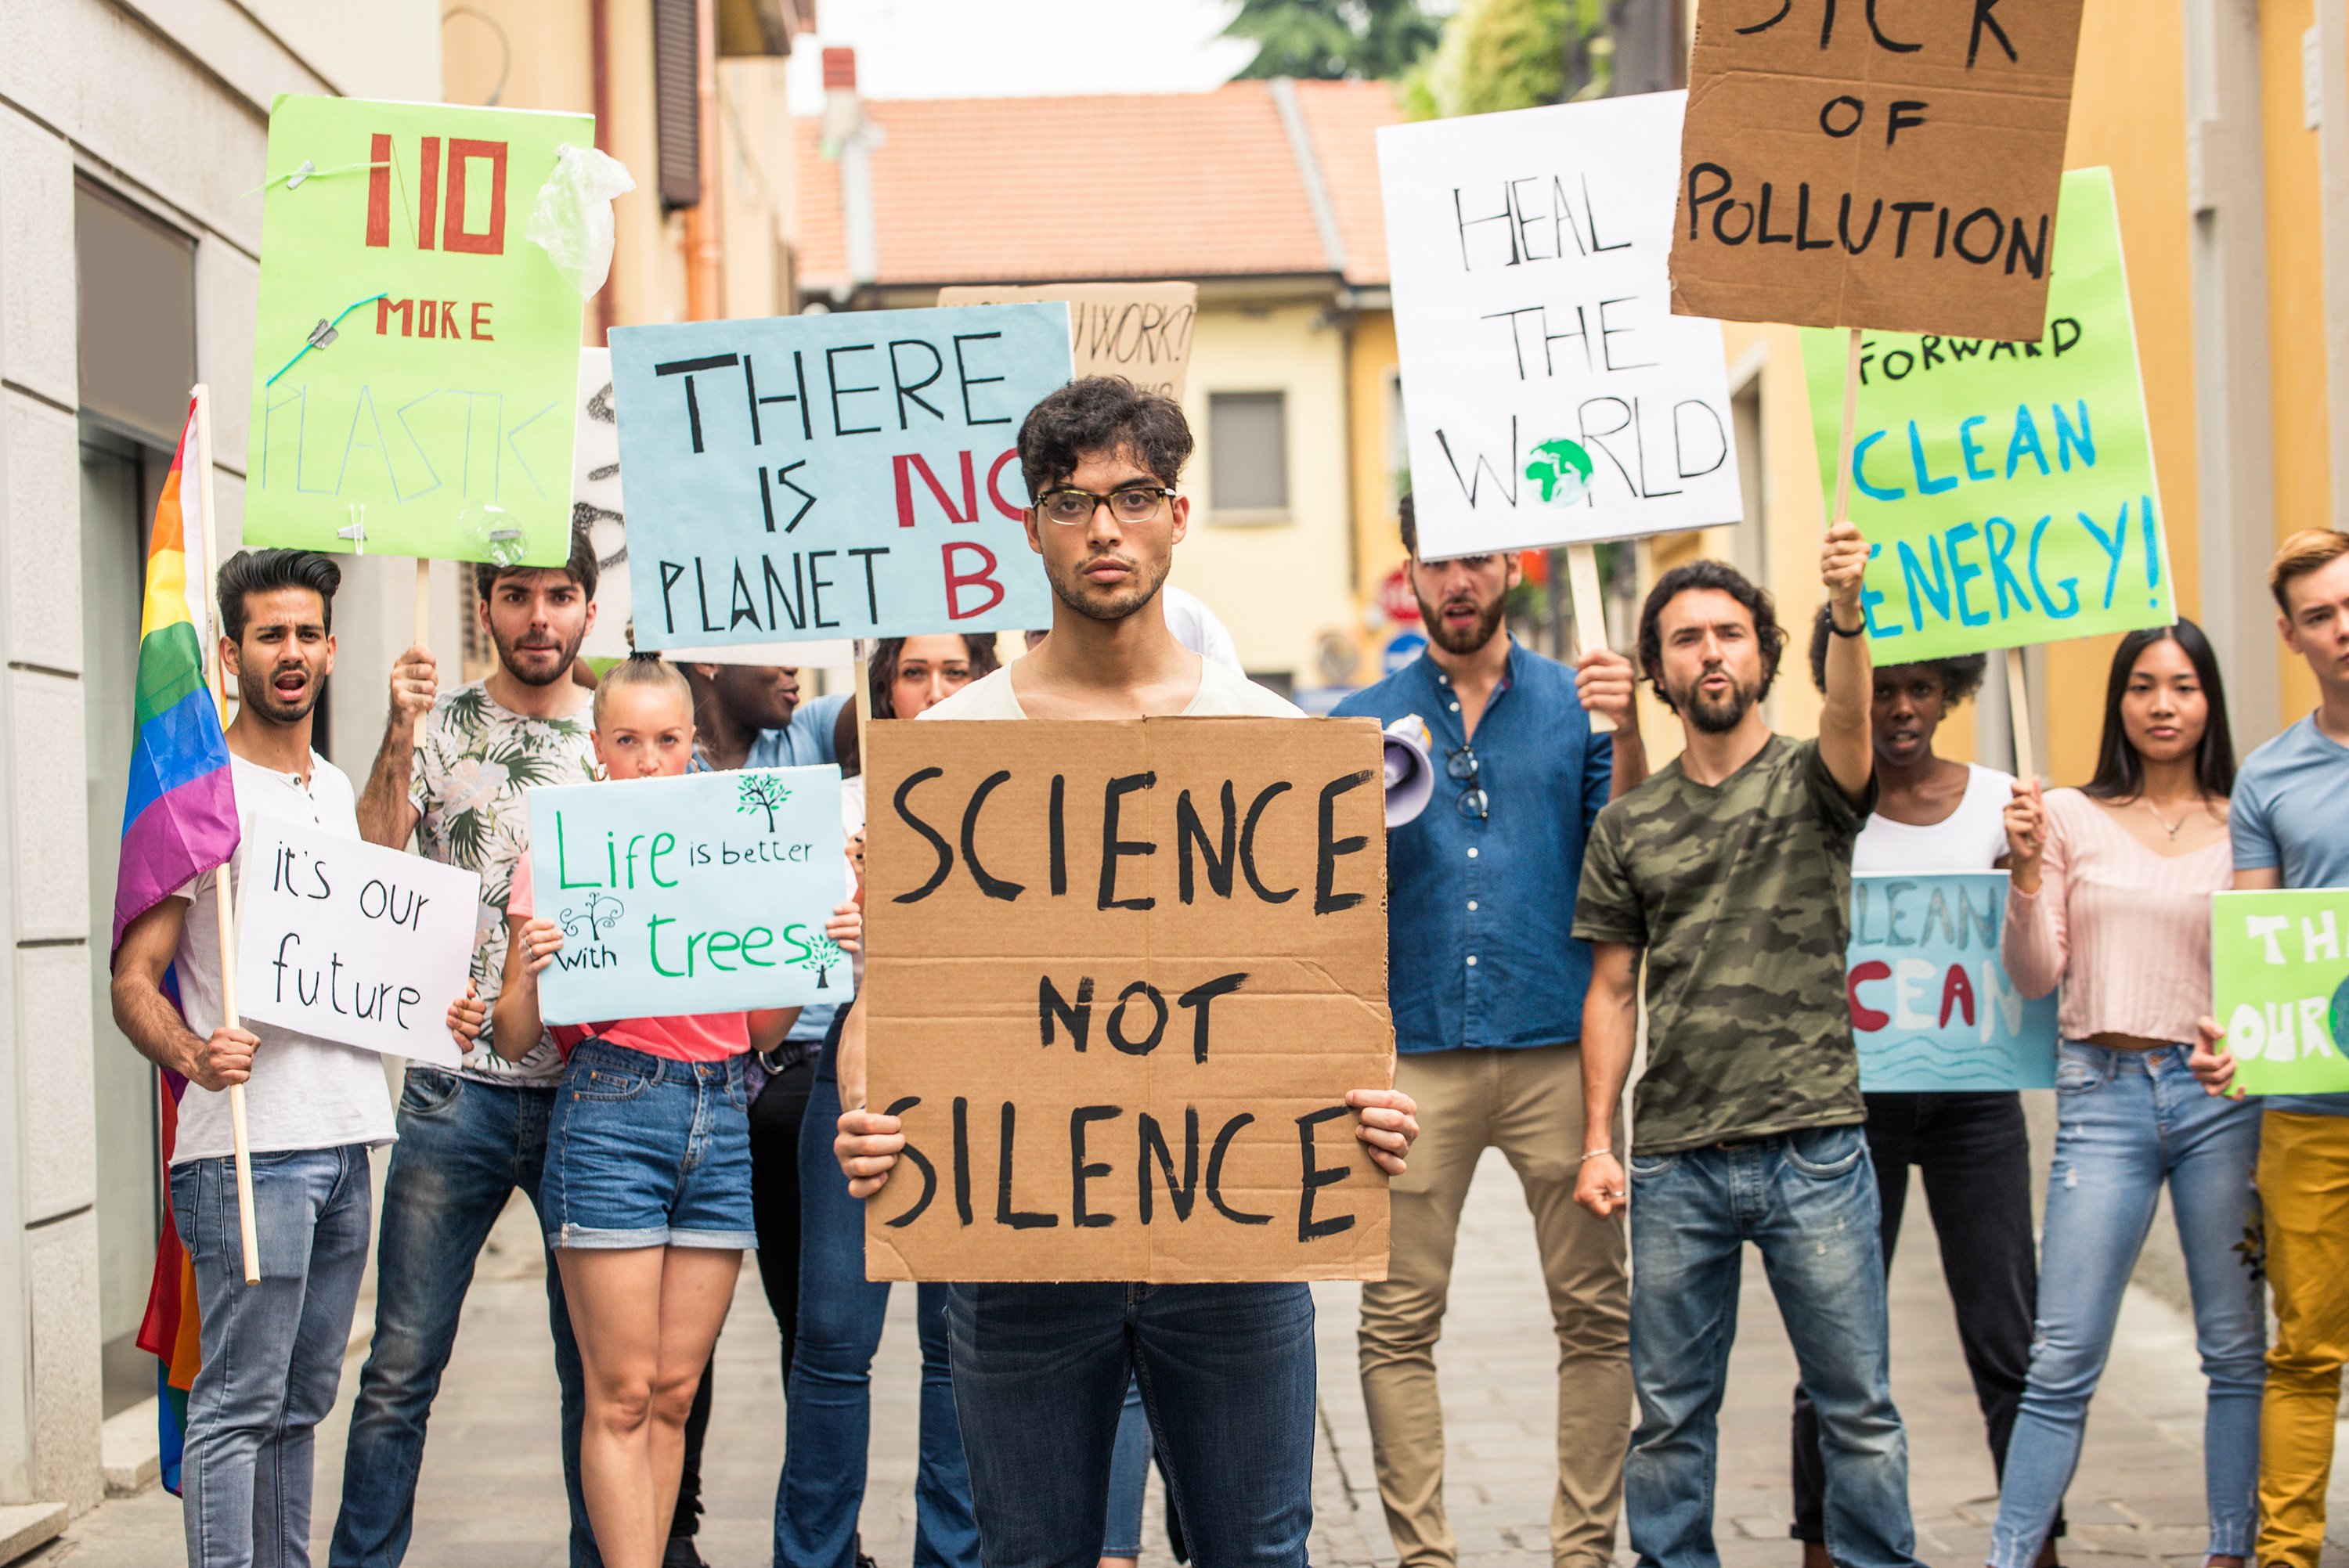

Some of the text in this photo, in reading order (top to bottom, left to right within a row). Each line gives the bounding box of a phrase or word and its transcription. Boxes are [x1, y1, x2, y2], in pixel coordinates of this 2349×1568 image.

[1820, 96, 1929, 147] OF
[366, 133, 507, 255] NO
[1452, 172, 1633, 271] HEAL
[1688, 162, 2049, 279] POLLUTION
[376, 298, 495, 341] MORE
[1481, 297, 1659, 380] THE
[655, 332, 1012, 454] THERE
[1853, 399, 2096, 501] CLEAN
[759, 460, 817, 533] IS
[660, 542, 1005, 633] PLANET B
[1860, 495, 2160, 639] ENERGY!
[274, 841, 430, 932] it's our
[556, 810, 813, 889] Life is better
[892, 766, 1375, 917] SCIENCE
[554, 914, 812, 978] with trees
[1856, 881, 1996, 951] LEAN
[2245, 910, 2349, 964] TH
[272, 932, 420, 1030] future
[1039, 972, 1250, 1065] NOT
[1846, 958, 2023, 1044] CEAN
[2228, 996, 2333, 1062] OUR
[883, 1096, 1356, 1242] SILENCE
